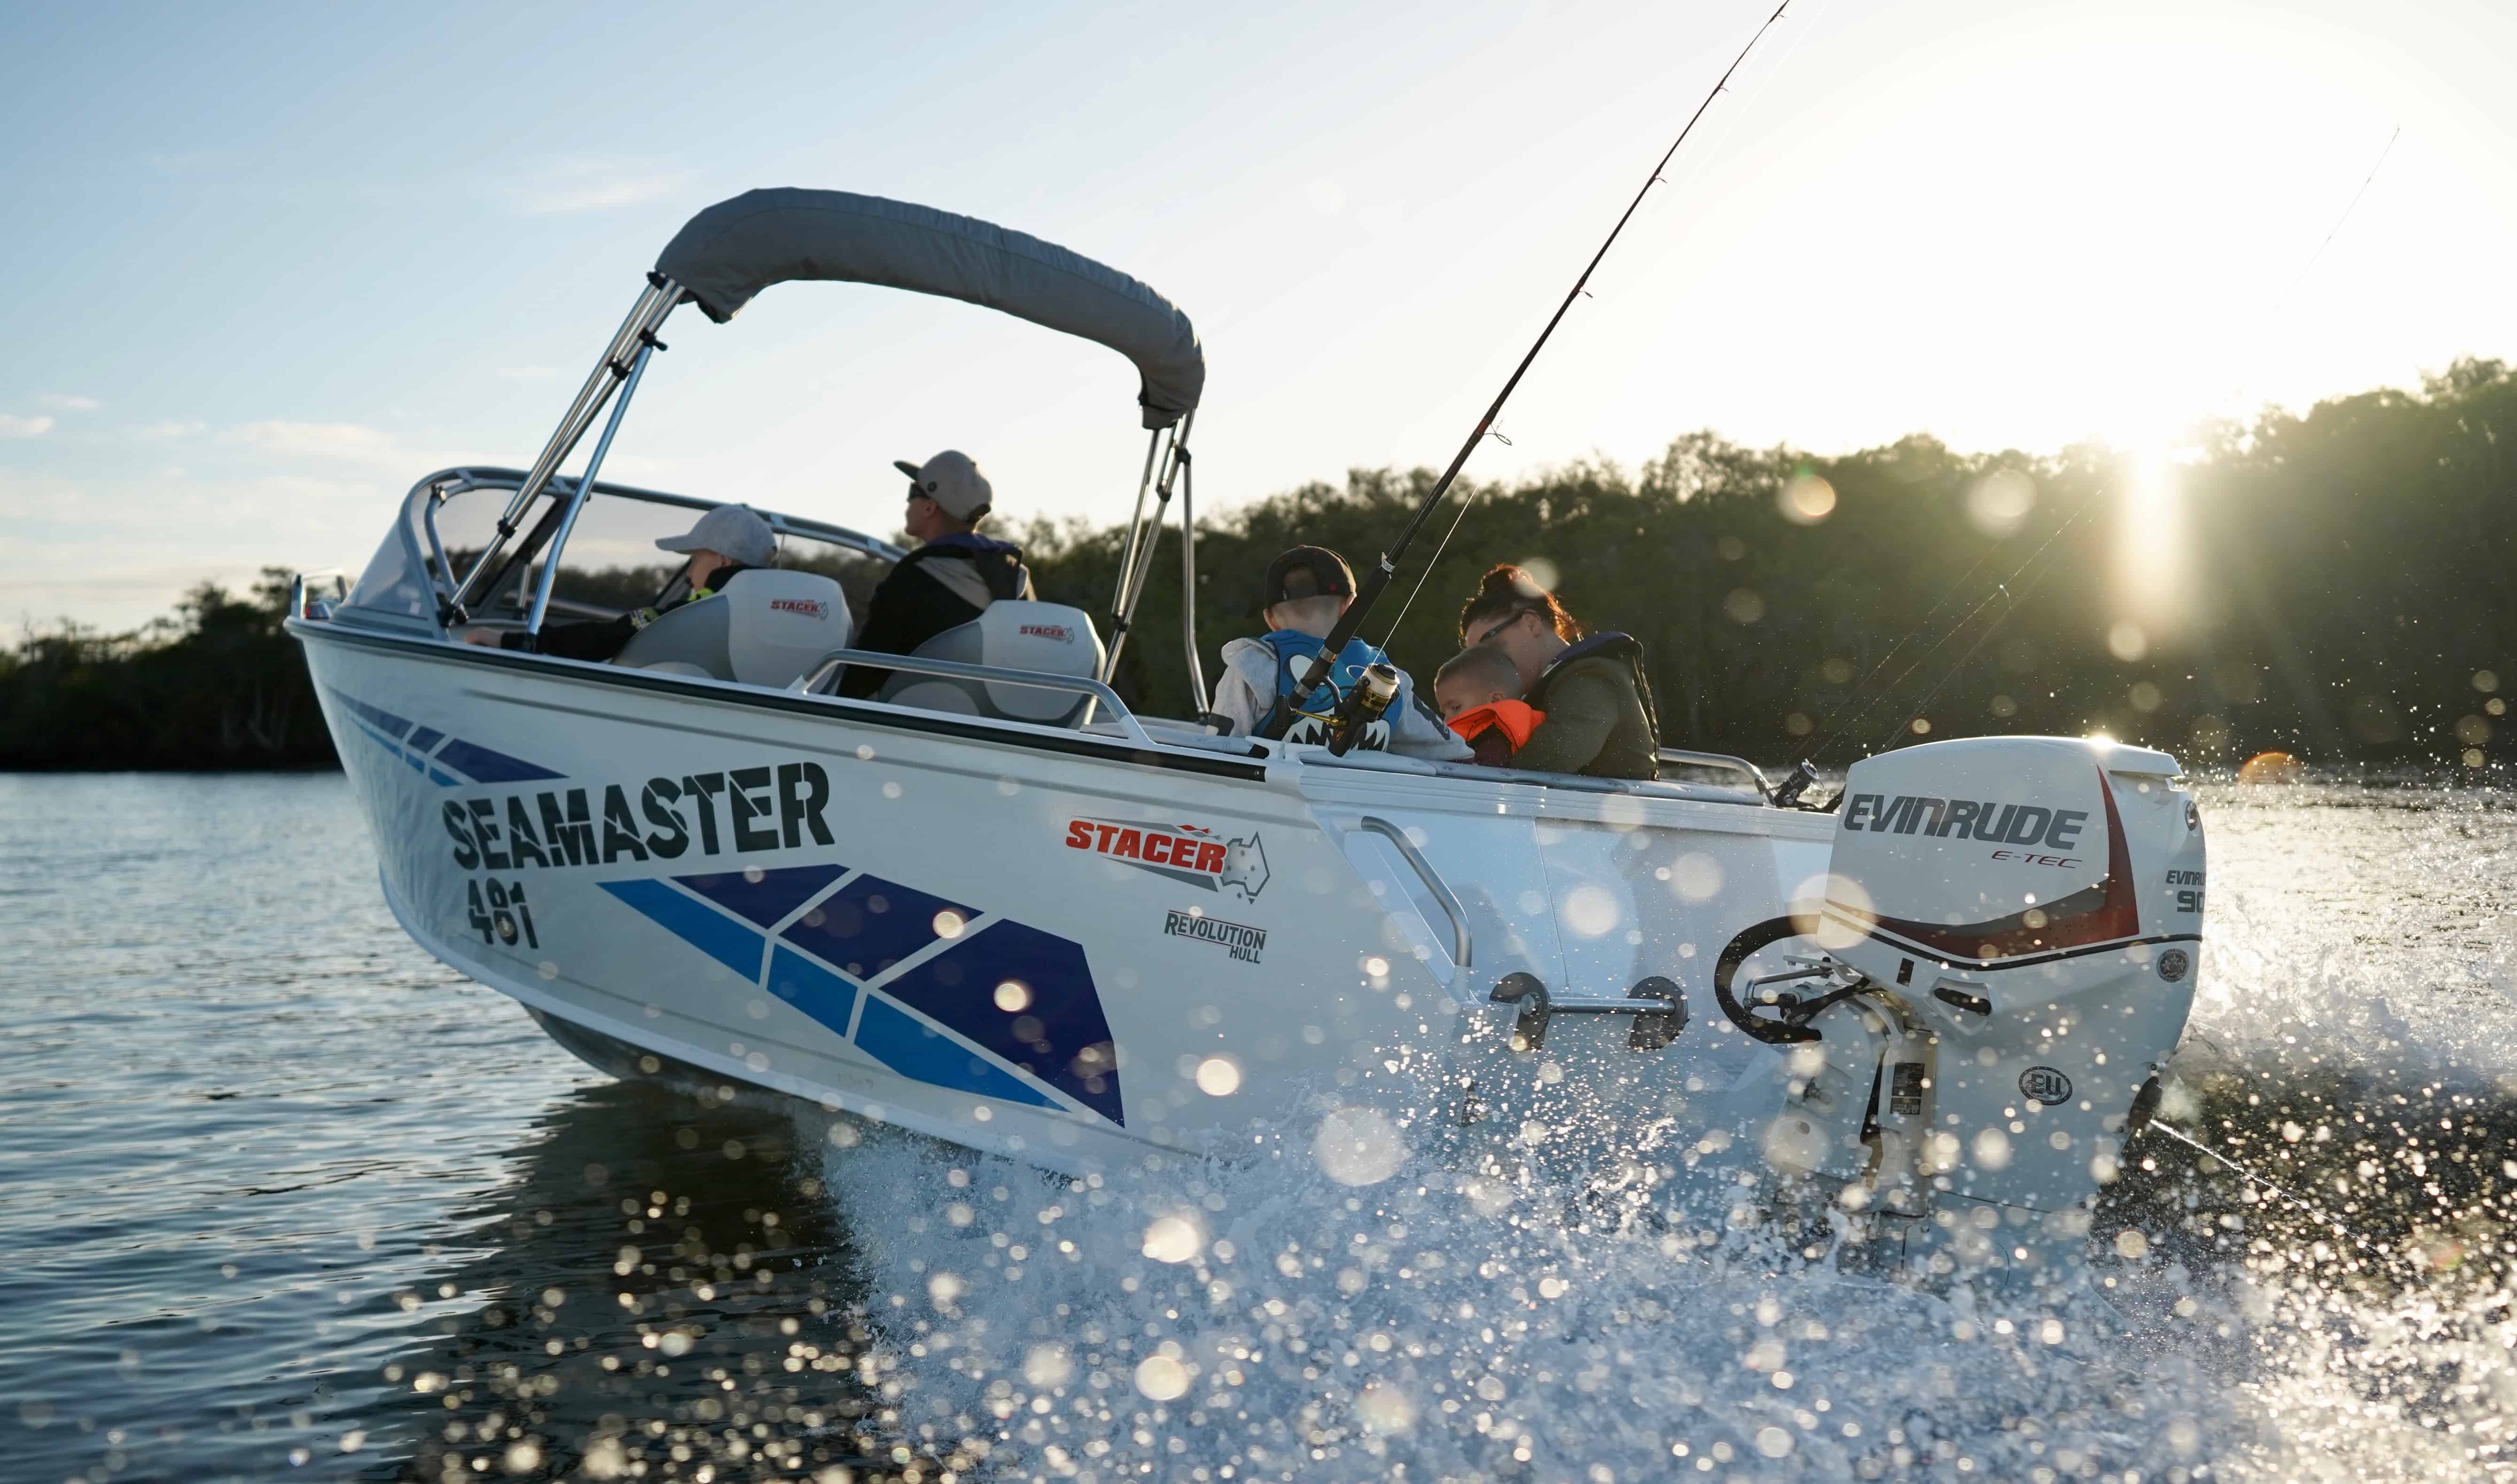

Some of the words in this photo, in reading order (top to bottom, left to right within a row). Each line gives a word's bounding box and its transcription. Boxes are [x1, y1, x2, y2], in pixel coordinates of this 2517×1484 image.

[442, 762, 835, 870] SEAMASTER
[1844, 794, 2089, 850] EVINRUDE
[1065, 820, 1227, 873] STACER
[1991, 850, 2082, 868] E-TEC
[468, 877, 539, 949] 481
[1164, 912, 1266, 950] REVOLUTION
[1229, 946, 1260, 964] HULL
